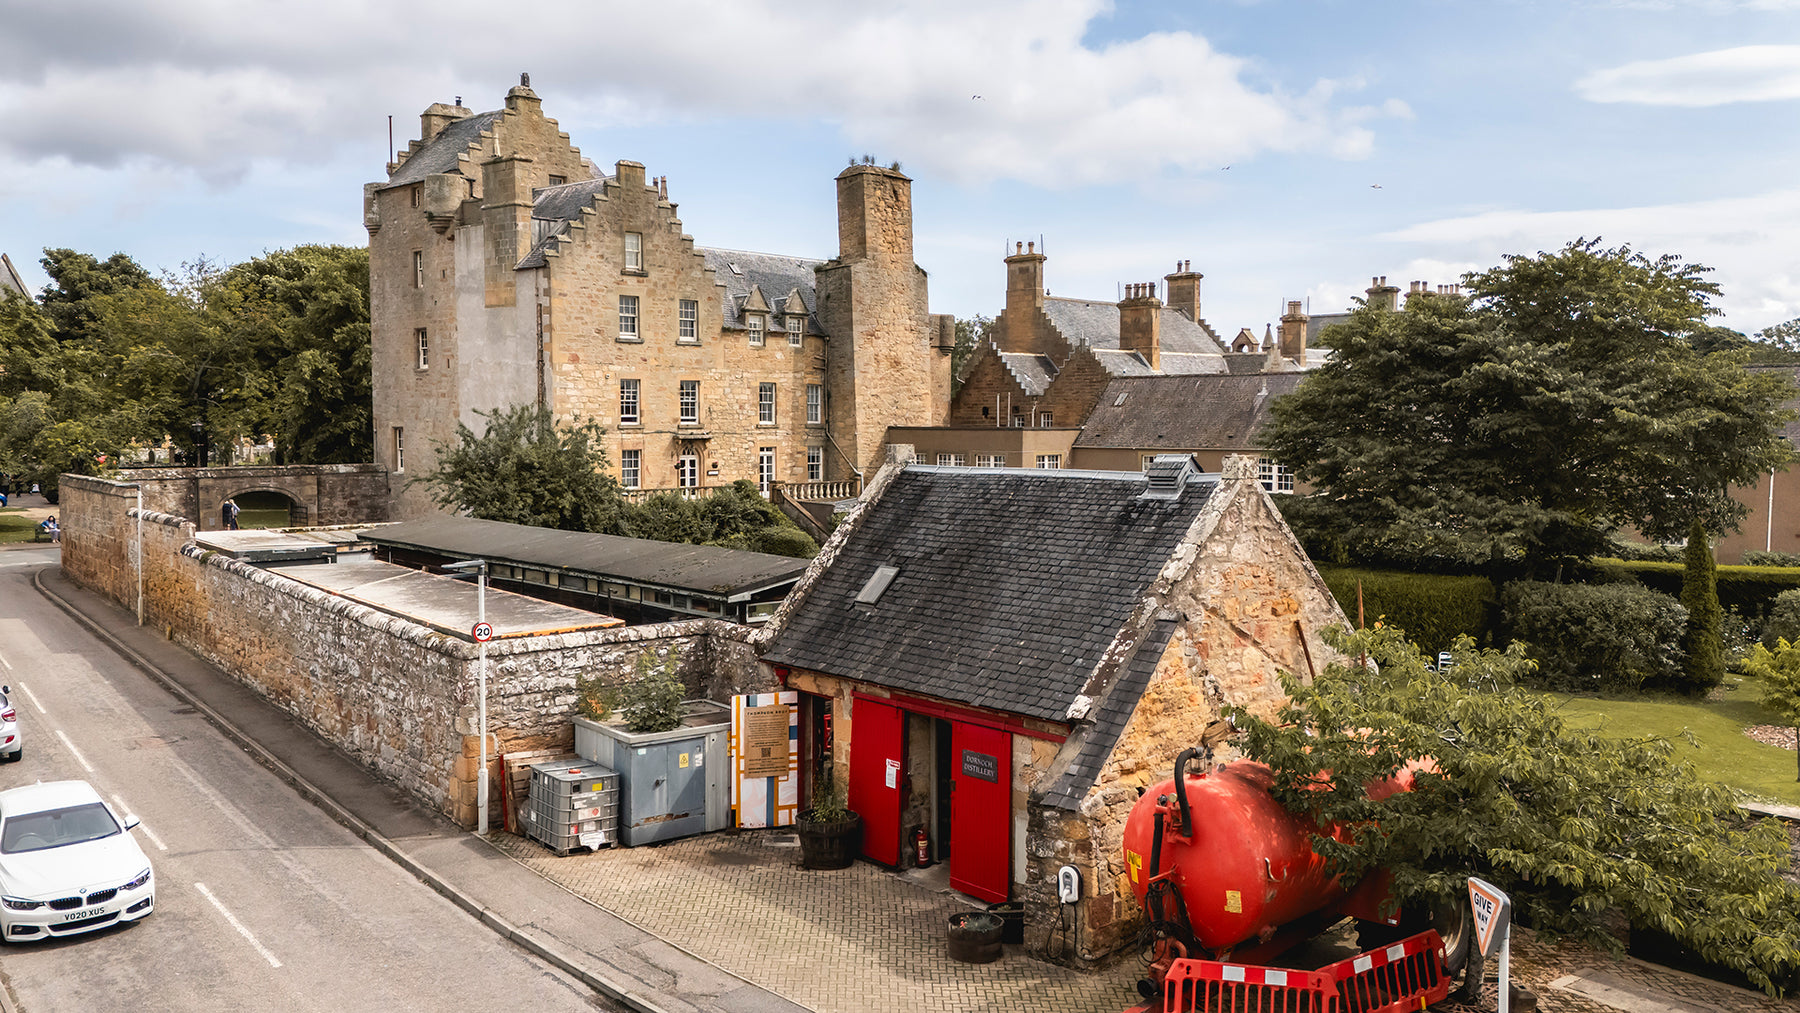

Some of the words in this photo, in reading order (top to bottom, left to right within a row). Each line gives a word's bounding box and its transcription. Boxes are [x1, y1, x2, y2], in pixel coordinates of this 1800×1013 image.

[476, 627, 490, 637] 20
[966, 755, 993, 769] DORNOCH
[964, 763, 994, 777] DISTILLERY
[1474, 892, 1492, 915] GIVE
[88, 906, 105, 917] XUS
[1477, 911, 1488, 925] WAY
